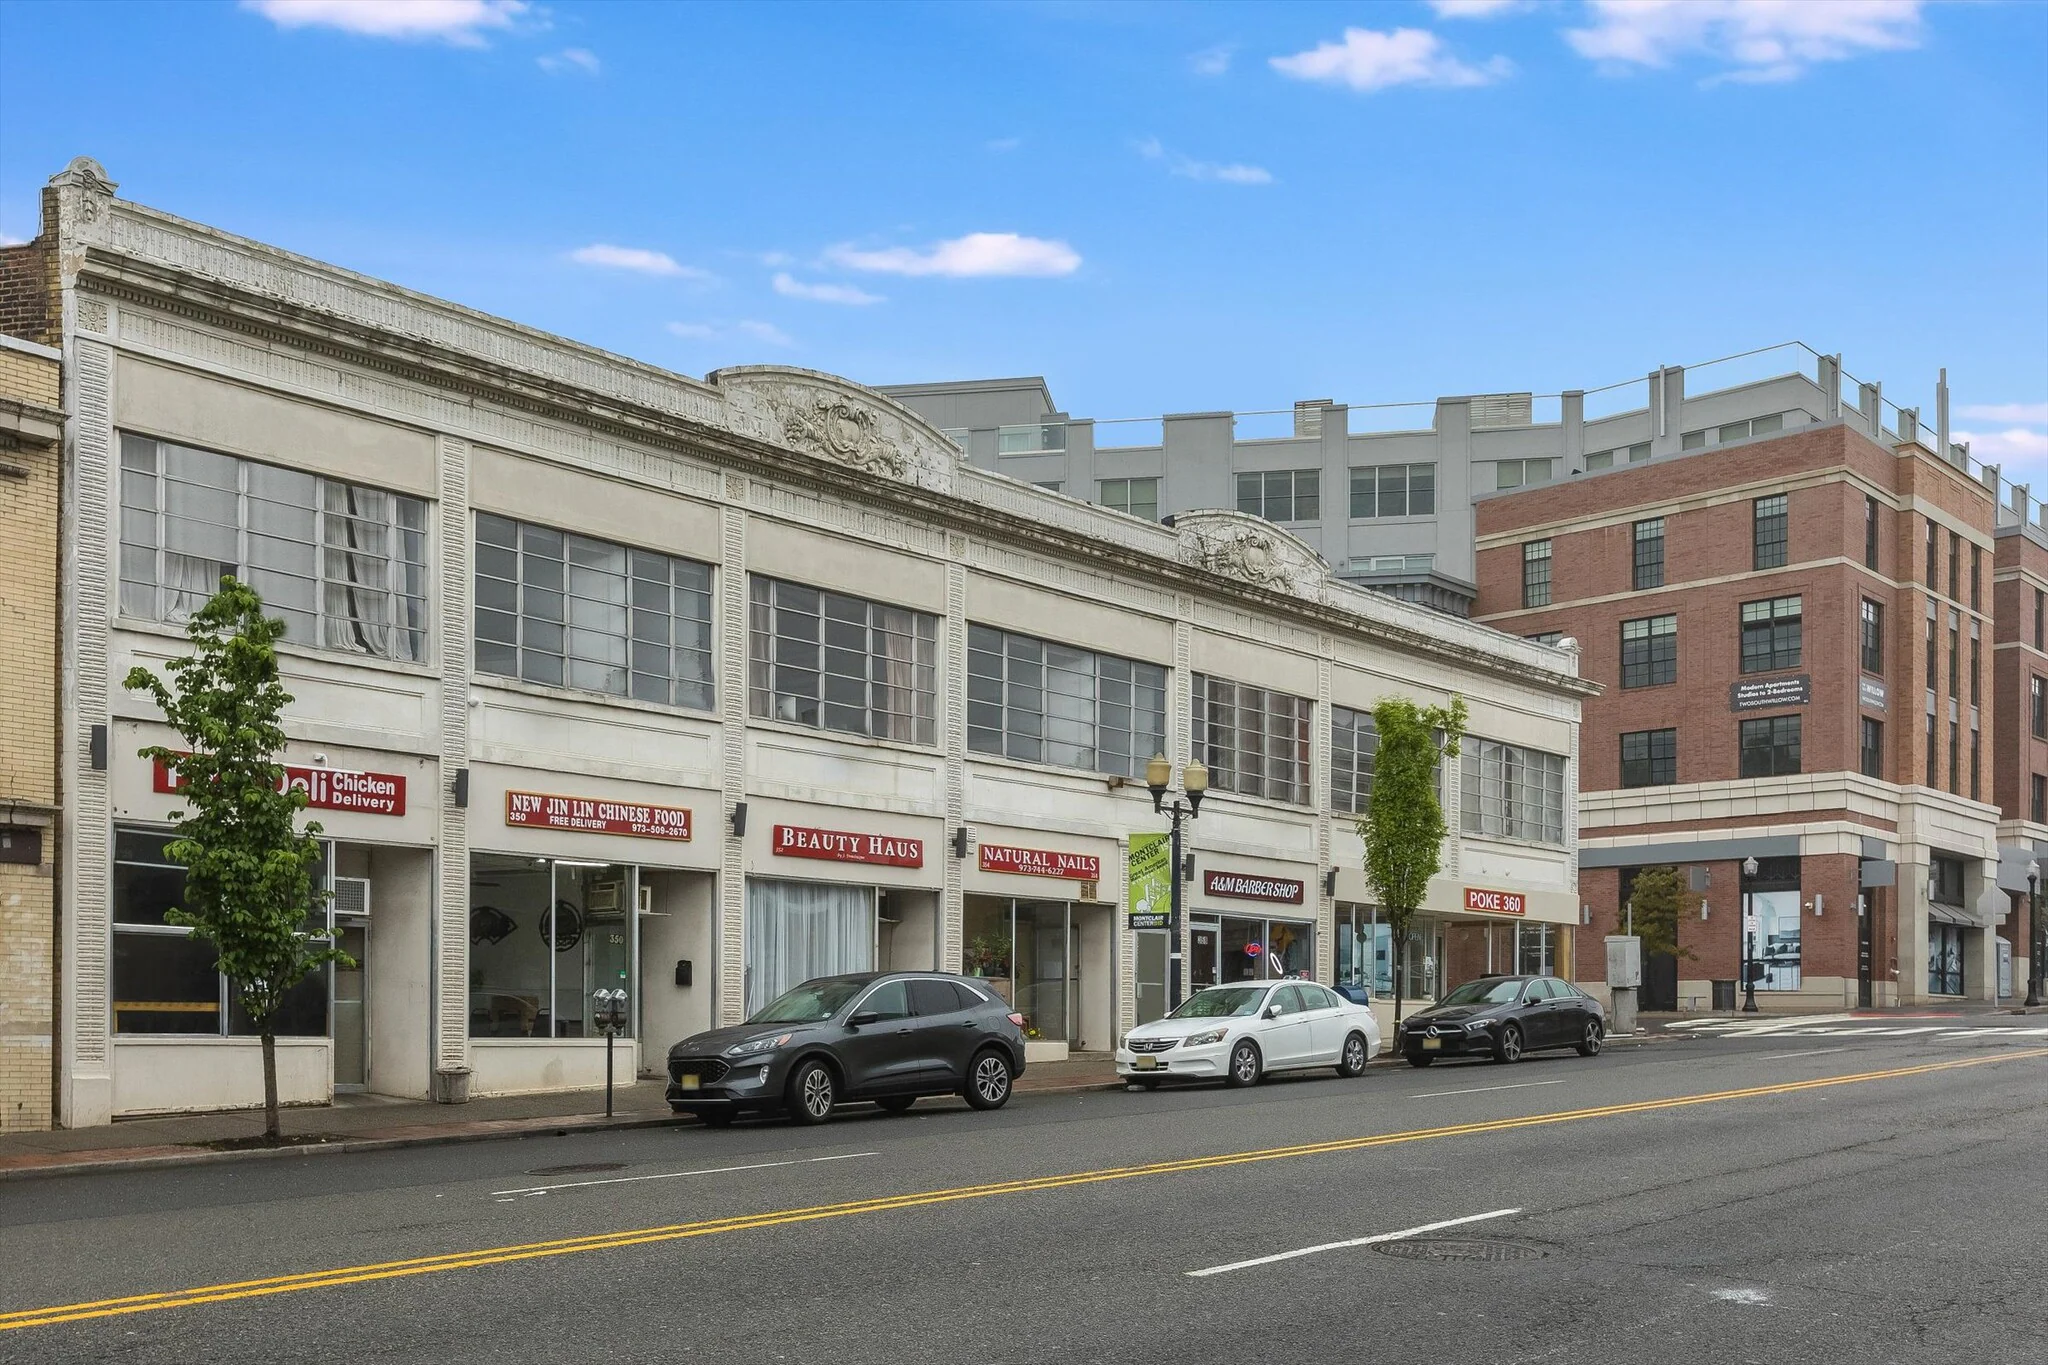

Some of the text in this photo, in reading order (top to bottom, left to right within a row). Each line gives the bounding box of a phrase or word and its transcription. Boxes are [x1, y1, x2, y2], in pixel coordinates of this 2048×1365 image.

[1765, 680, 1800, 689] Apartments
[332, 772, 396, 796] Chicken
[332, 793, 394, 812] Delivery
[512, 794, 685, 828] NEW JIN LIN CHINESE FOOD
[510, 812, 526, 822] 350
[550, 816, 606, 830] FREE DELIVERY
[632, 824, 688, 837] 973-509-2670
[782, 827, 918, 859] BEAUTY HAUS
[1129, 835, 1170, 860] MONTCLAIR
[984, 847, 1096, 871] NATURAL NAILS
[1131, 848, 1160, 866] CENTER
[1210, 876, 1298, 898] A&M BARBER SHOP
[1470, 892, 1520, 912] POKE 360
[610, 934, 624, 944] 350
